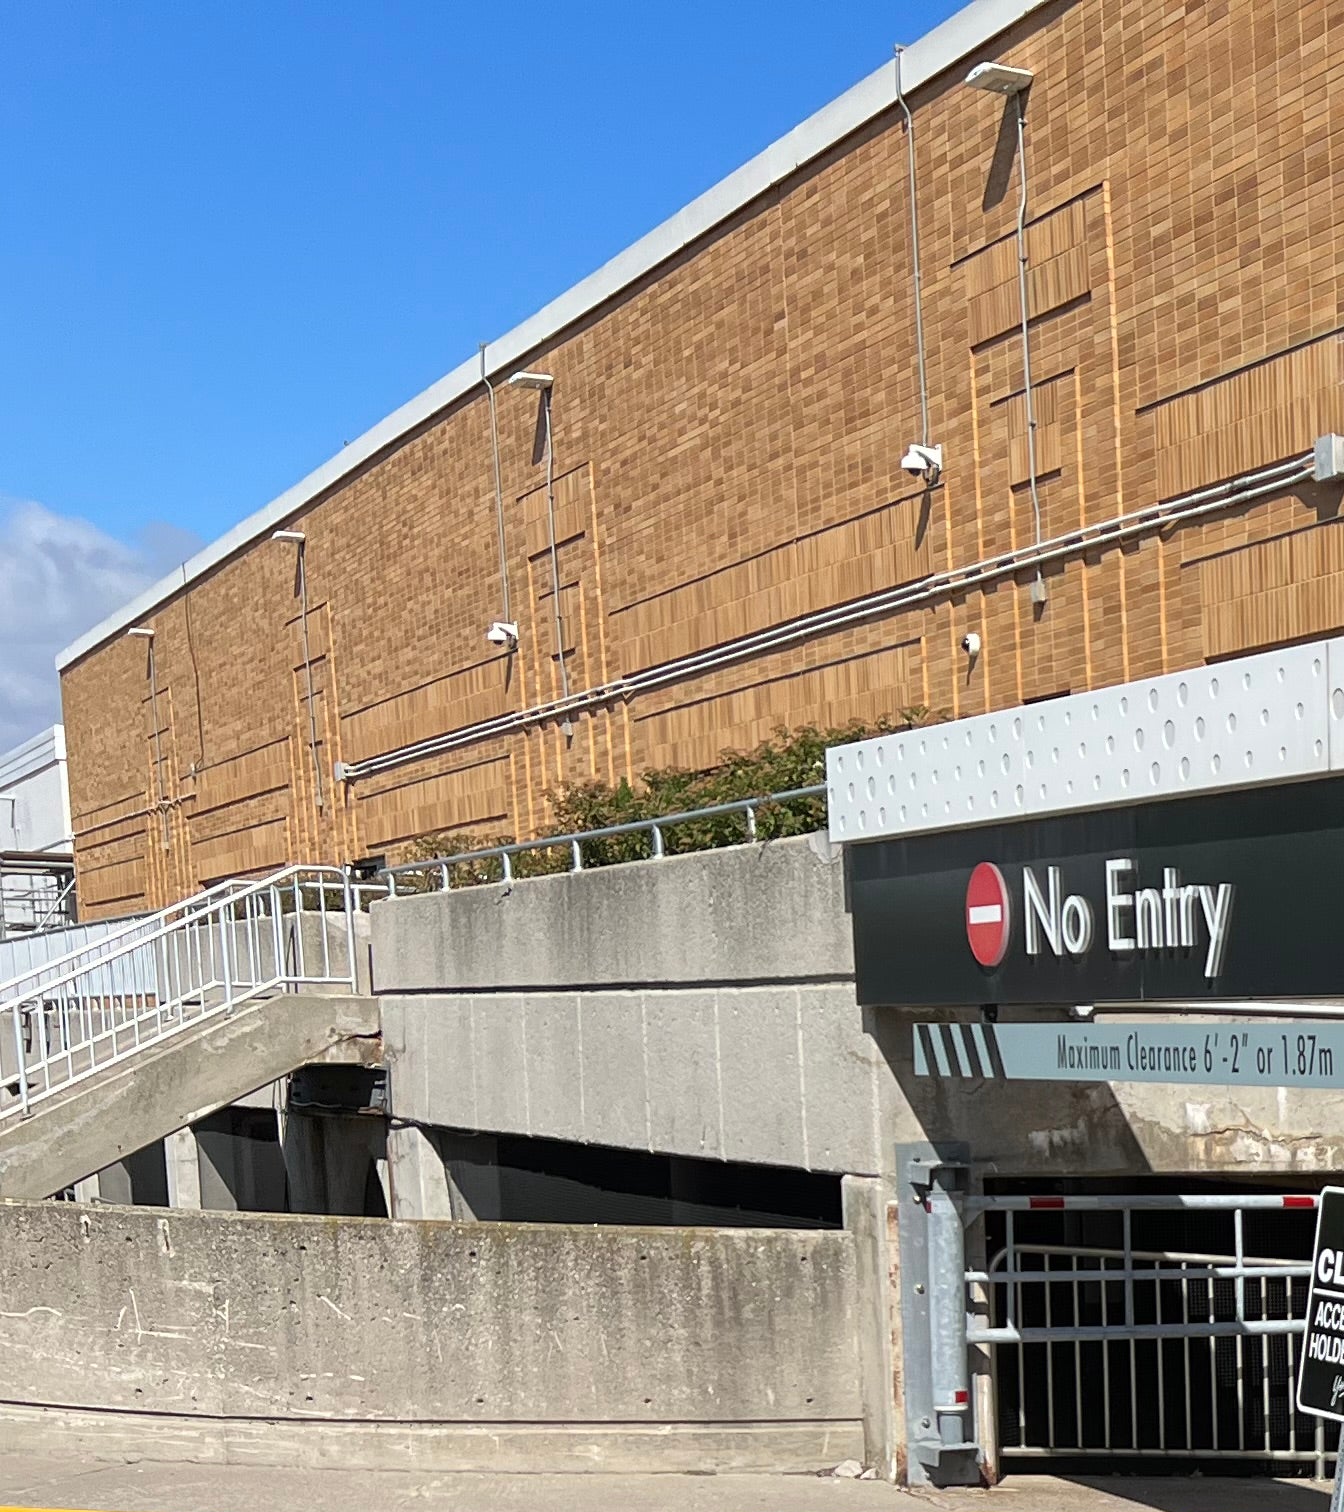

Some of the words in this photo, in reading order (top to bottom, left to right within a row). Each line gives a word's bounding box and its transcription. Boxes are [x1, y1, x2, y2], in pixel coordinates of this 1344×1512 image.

[1022, 866, 1091, 956] No
[1105, 857, 1233, 978] Entry
[1057, 1034, 1121, 1070] Maximum
[1127, 1031, 1197, 1072] Clearance
[1256, 1045, 1273, 1074] or
[1281, 1034, 1334, 1076] 1.87m
